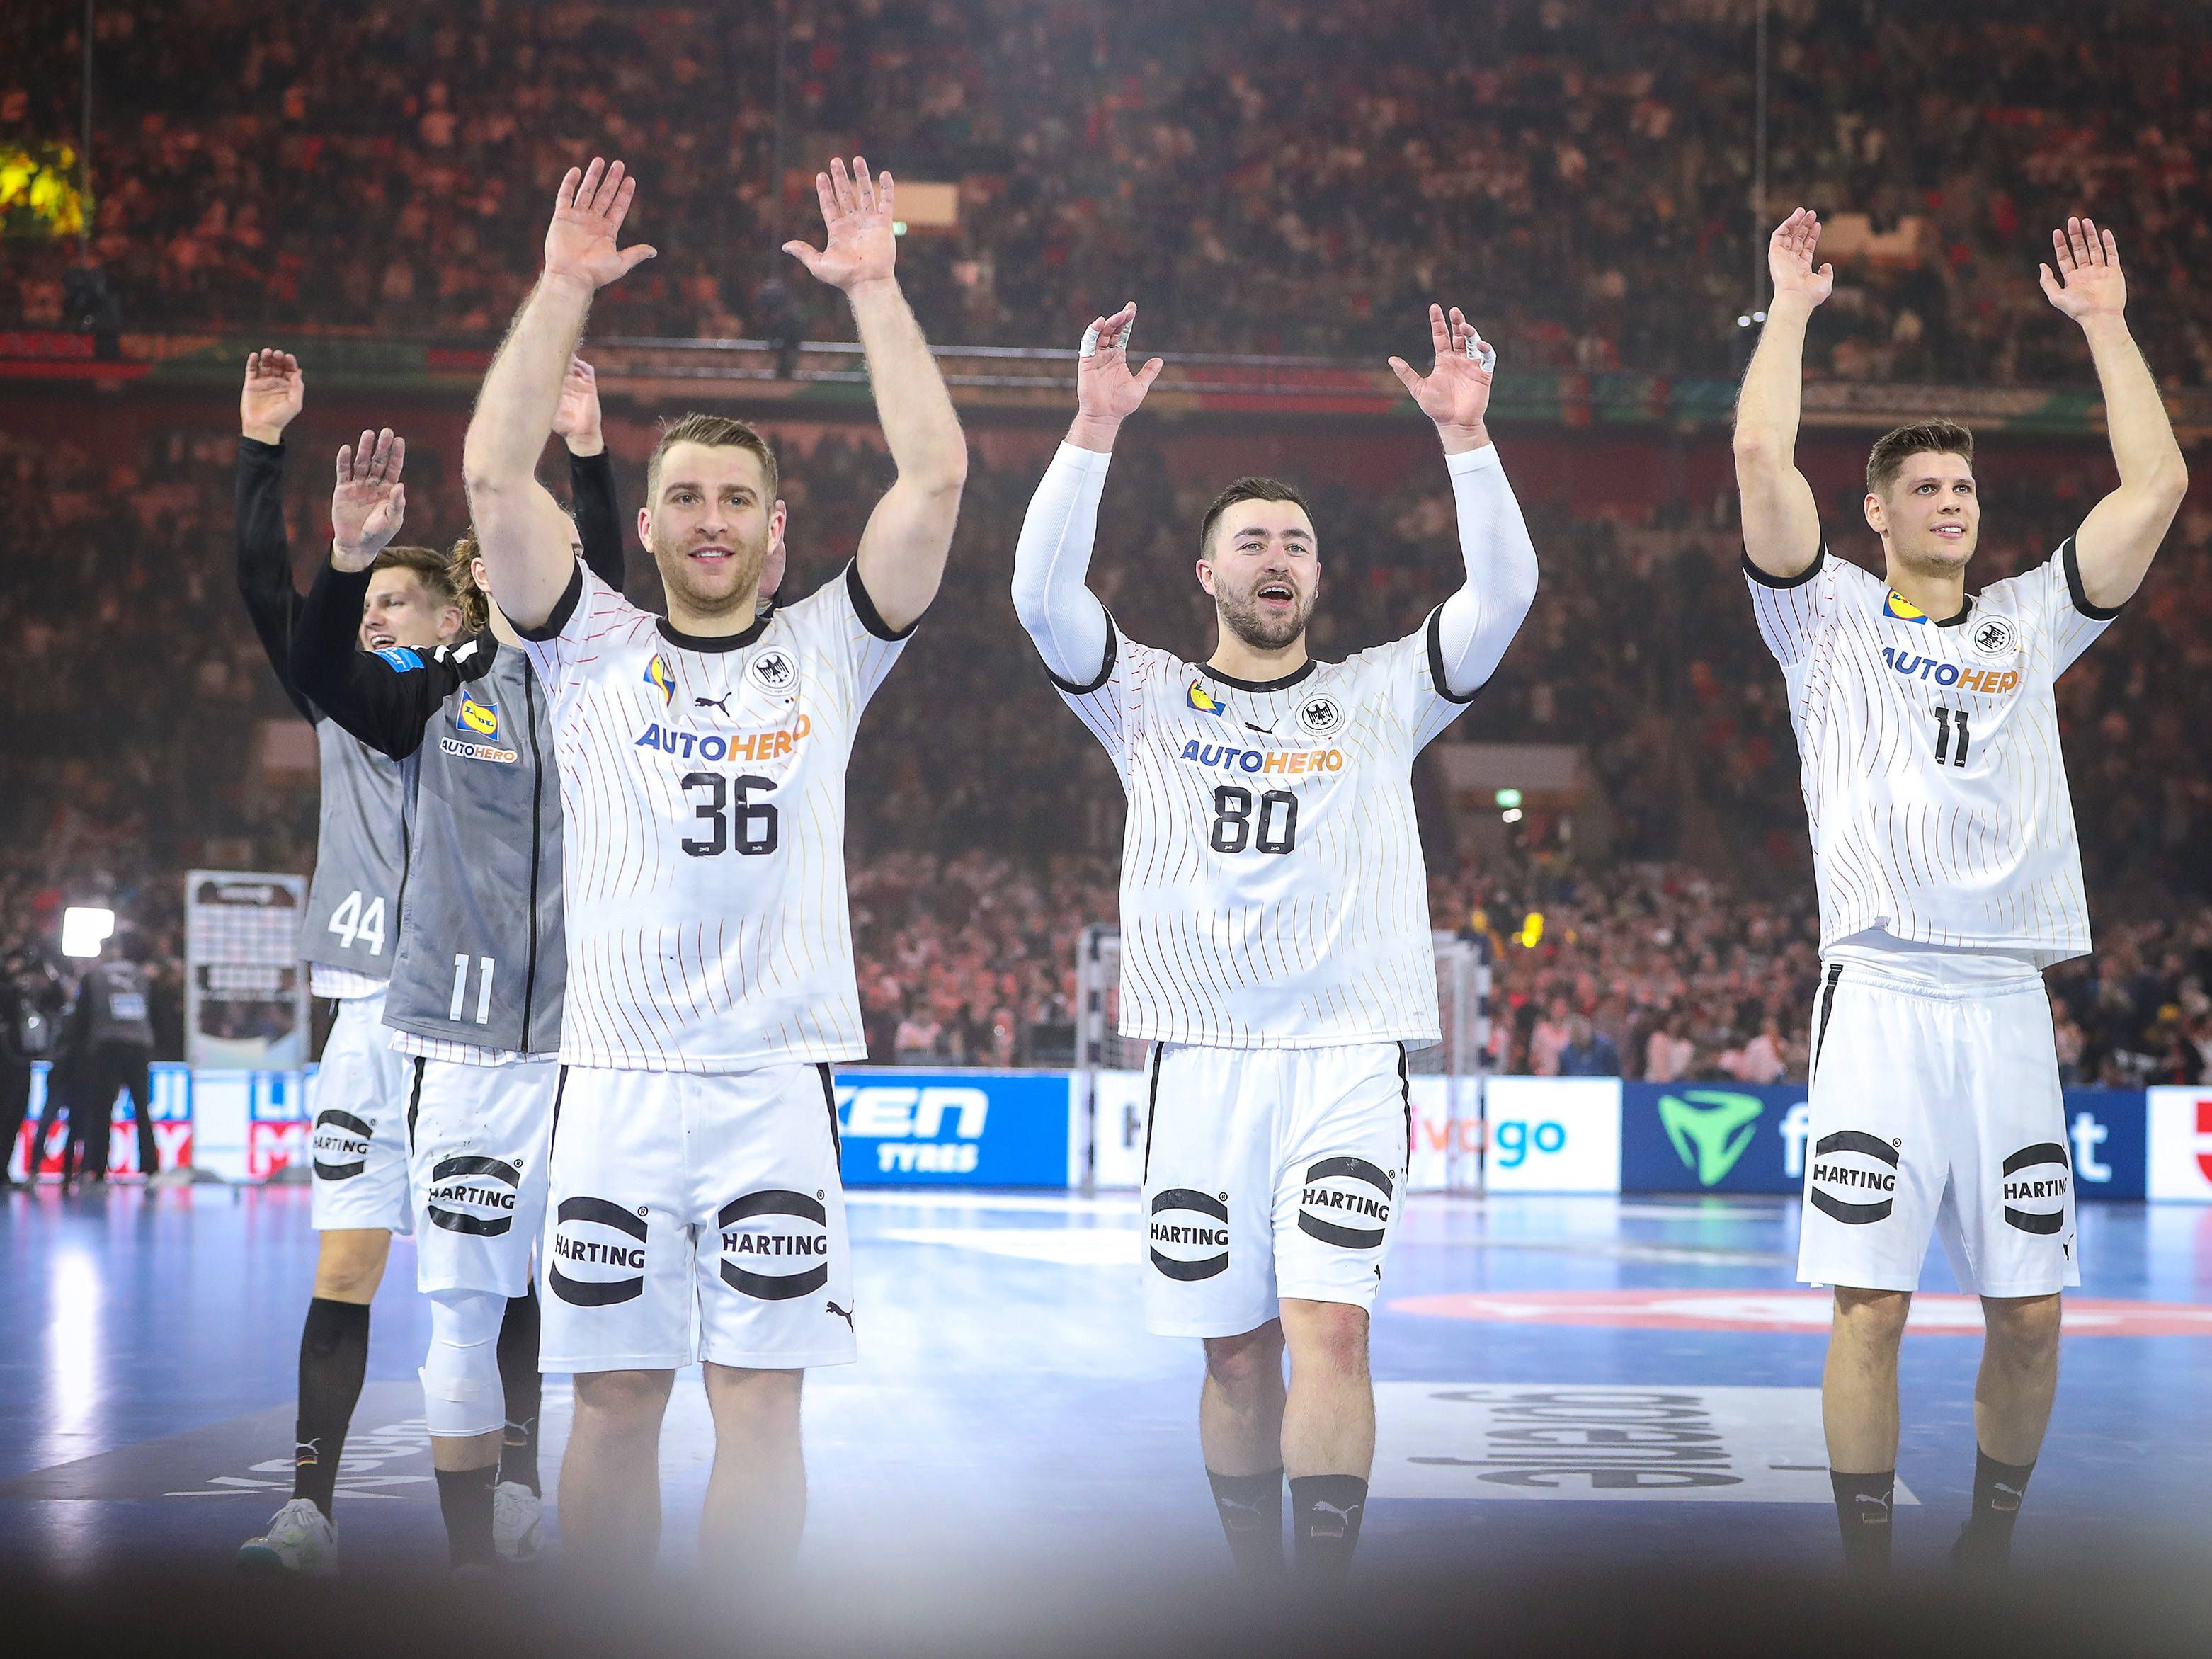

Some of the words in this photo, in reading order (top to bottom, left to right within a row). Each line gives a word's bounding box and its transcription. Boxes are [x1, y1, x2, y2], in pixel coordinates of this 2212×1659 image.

[441, 739, 515, 762] AUTOHERO
[634, 713, 811, 762] AUTOHERO
[1934, 707, 1970, 768] 11
[1180, 739, 1343, 774] AUTOHERO
[681, 772, 778, 856] 36
[1209, 785, 1298, 855] 80
[328, 890, 386, 956] 44
[449, 952, 495, 1025] 11
[877, 1143, 979, 1173] TYRES
[1813, 1163, 1895, 1192] HARTING
[428, 1185, 515, 1210] HARTING
[1301, 1188, 1389, 1223] HARTING
[554, 1233, 646, 1270] HARTING
[722, 1232, 828, 1256] HARTING
[1150, 1222, 1228, 1246] HARTING
